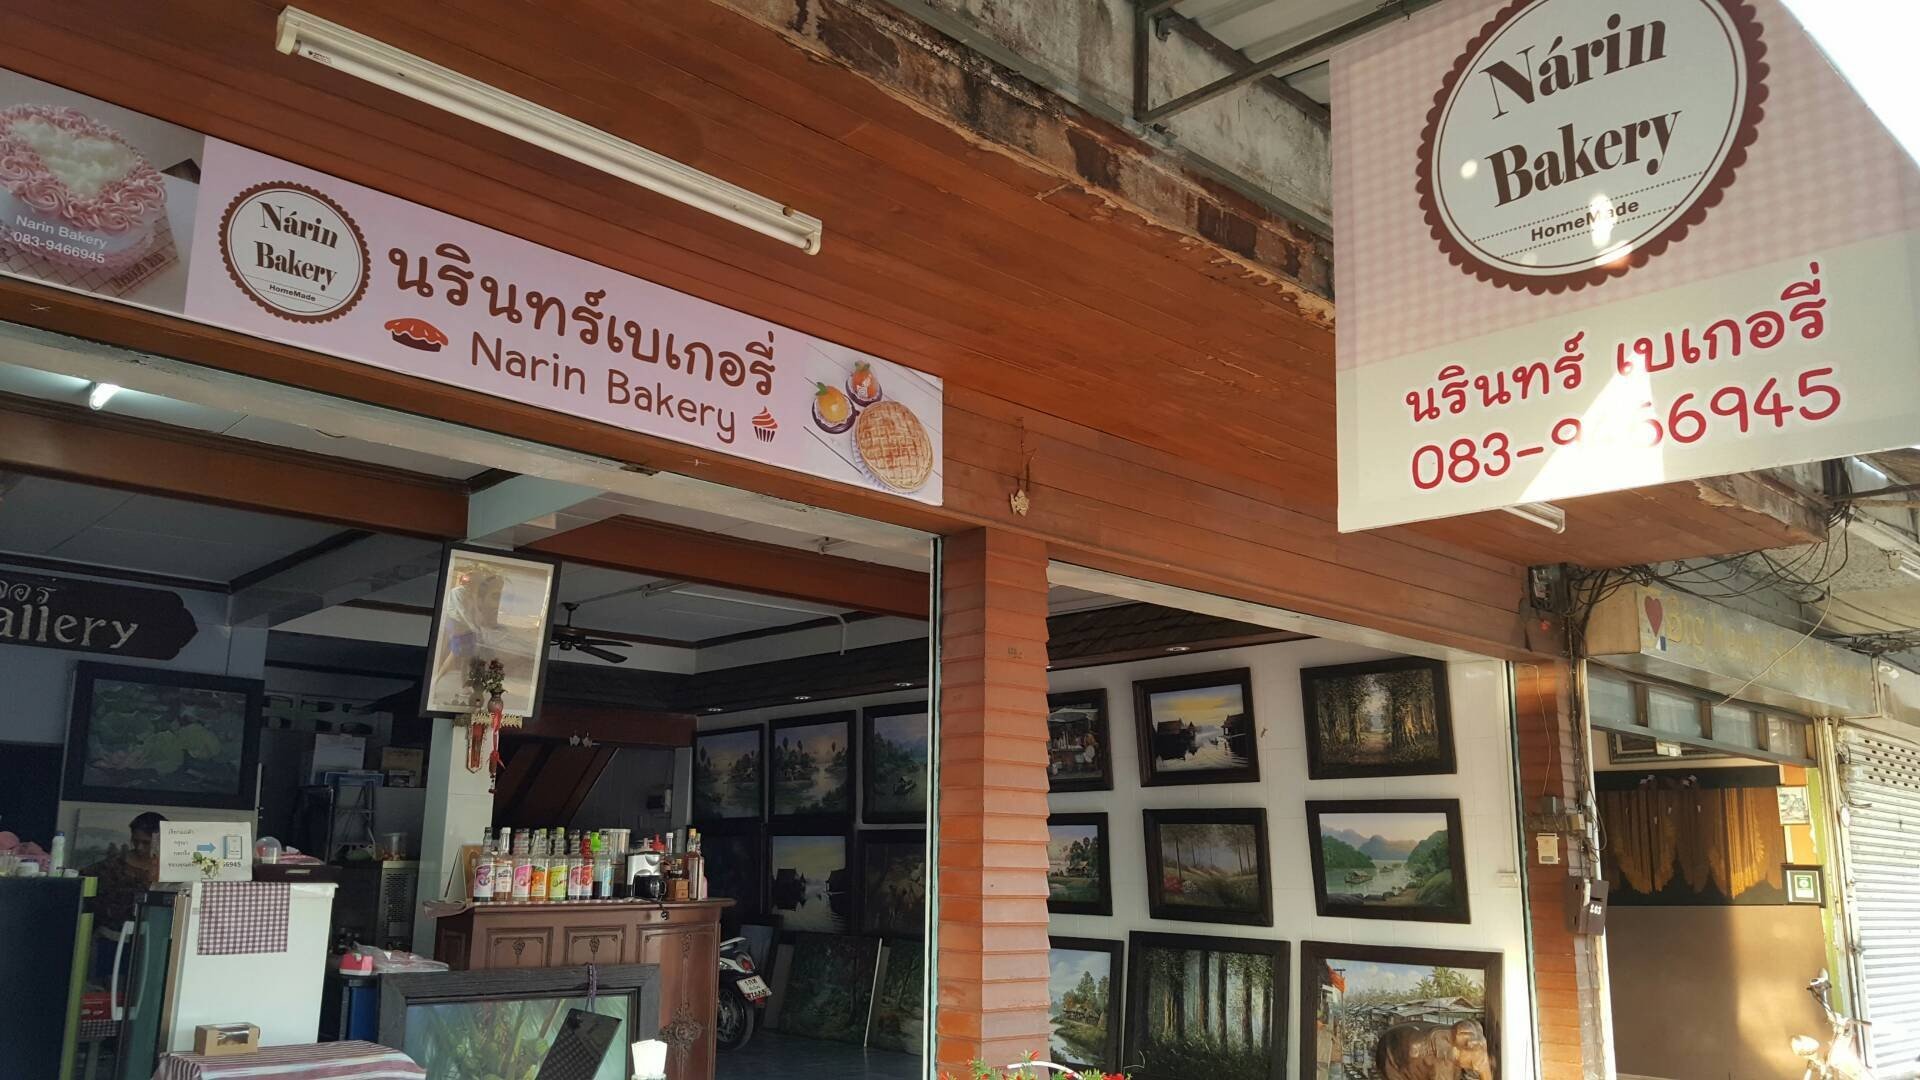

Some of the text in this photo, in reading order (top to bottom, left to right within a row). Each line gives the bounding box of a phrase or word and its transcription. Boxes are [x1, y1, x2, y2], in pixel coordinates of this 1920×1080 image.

[1479, 13, 1666, 120] Nárin
[1484, 110, 1682, 207] Bakery
[13, 231, 105, 264] 083-9466945
[16, 214, 108, 249] Narin Bakery
[254, 240, 337, 291] Bakery
[257, 201, 338, 249] Nárin
[269, 284, 316, 302] HomeMade
[388, 243, 777, 396] นรินทร์เบเกอรี่
[1406, 261, 1827, 422] นรินทร์ เบเกอรี่
[471, 331, 736, 444] Narin Bakery
[1411, 368, 1842, 490] 083-96945
